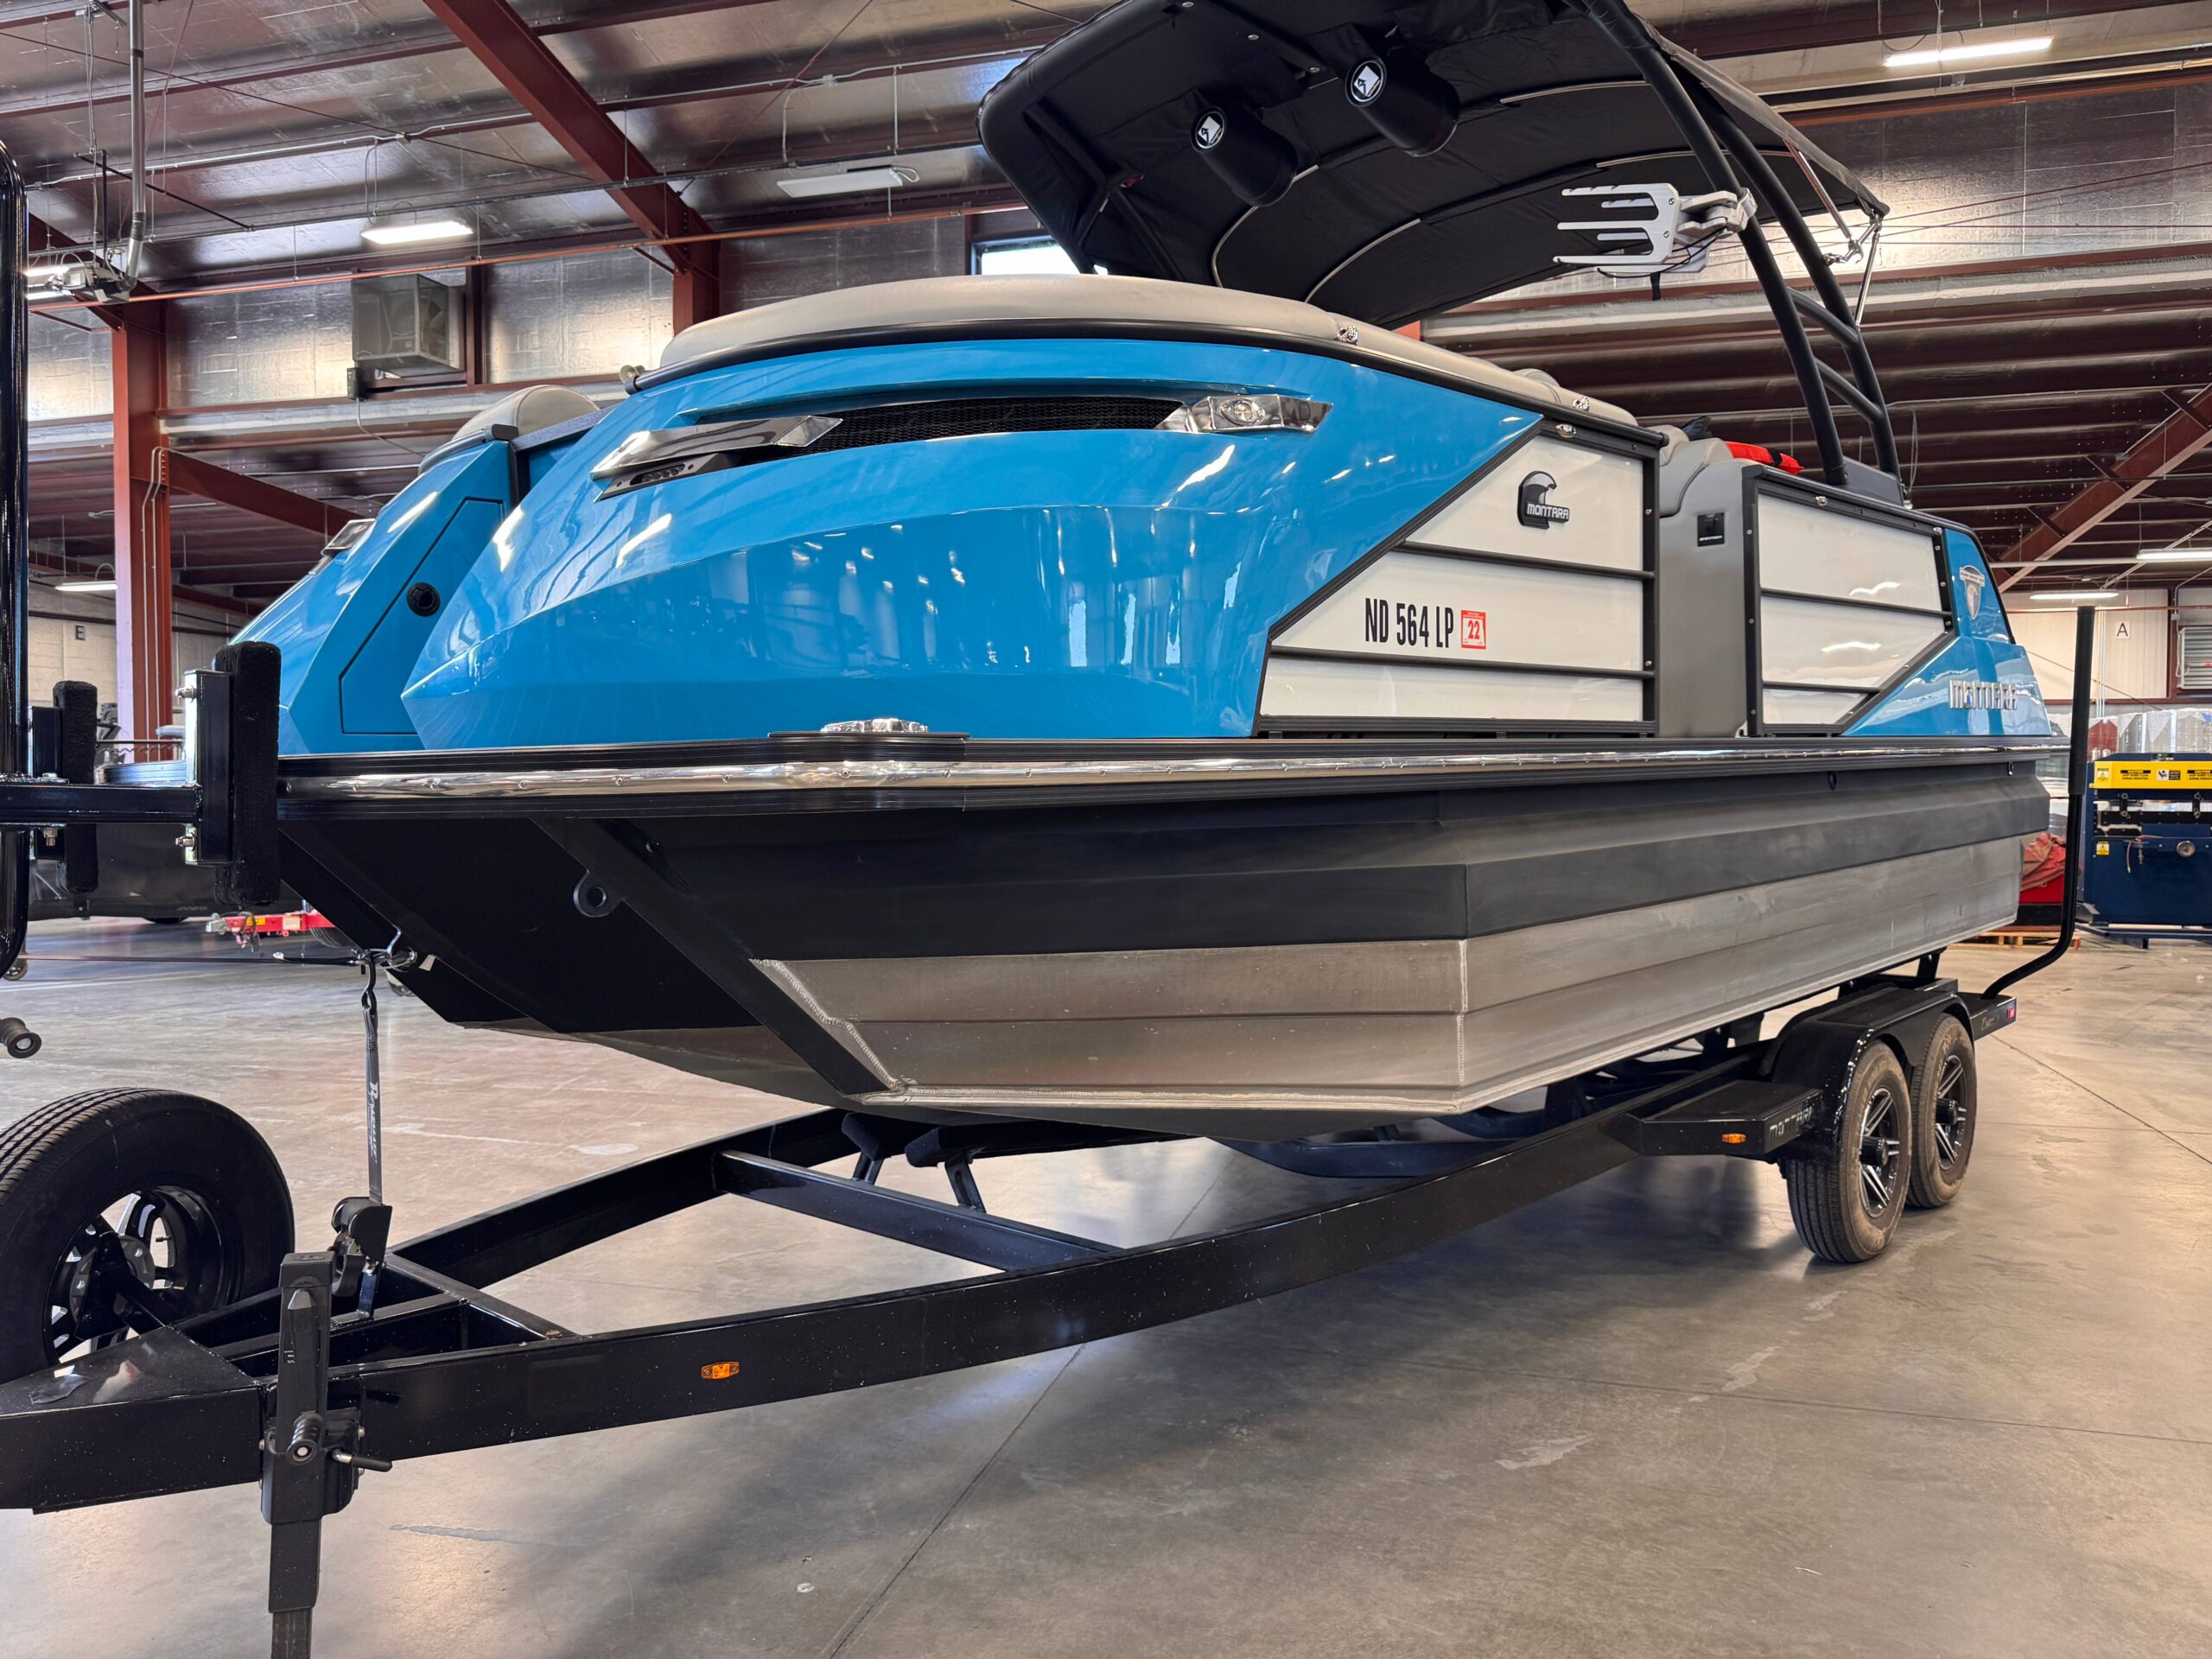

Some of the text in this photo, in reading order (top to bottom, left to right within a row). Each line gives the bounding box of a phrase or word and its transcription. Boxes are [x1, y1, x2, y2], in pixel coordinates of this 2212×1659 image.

[1527, 503, 1569, 520] MONTARA
[1365, 597, 1454, 648] ND 564 LP
[1468, 620, 1480, 639] 22
[2116, 622, 2128, 637] A
[75, 625, 86, 640] E
